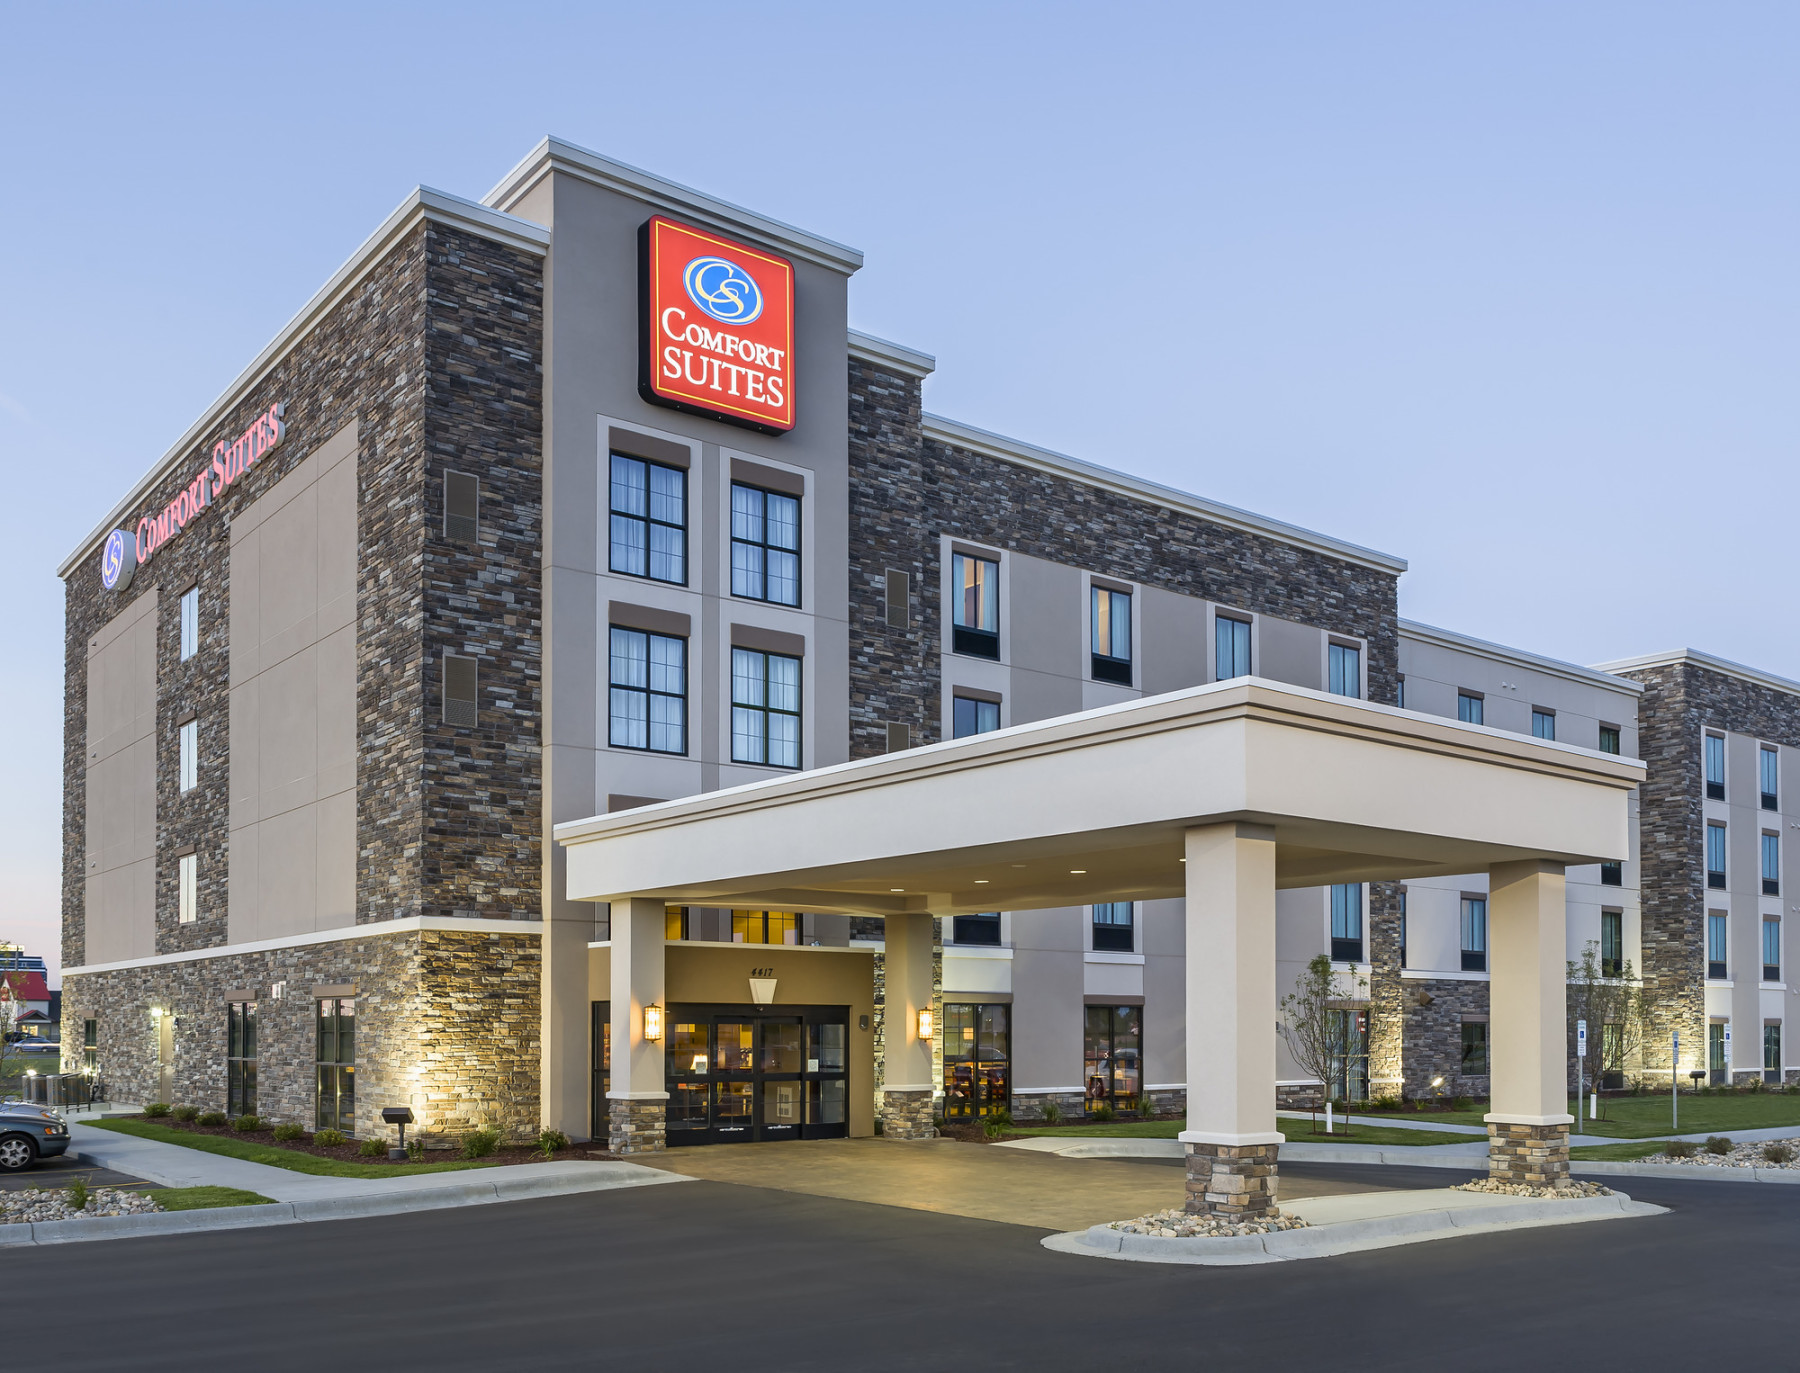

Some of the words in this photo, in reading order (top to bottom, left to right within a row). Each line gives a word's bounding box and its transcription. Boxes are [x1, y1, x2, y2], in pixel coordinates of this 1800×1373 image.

[661, 306, 785, 371] COMFORT
[663, 346, 784, 408] SUITES
[135, 468, 210, 565] COMFORT
[211, 402, 281, 498] SUITES
[751, 967, 774, 977] 4417
